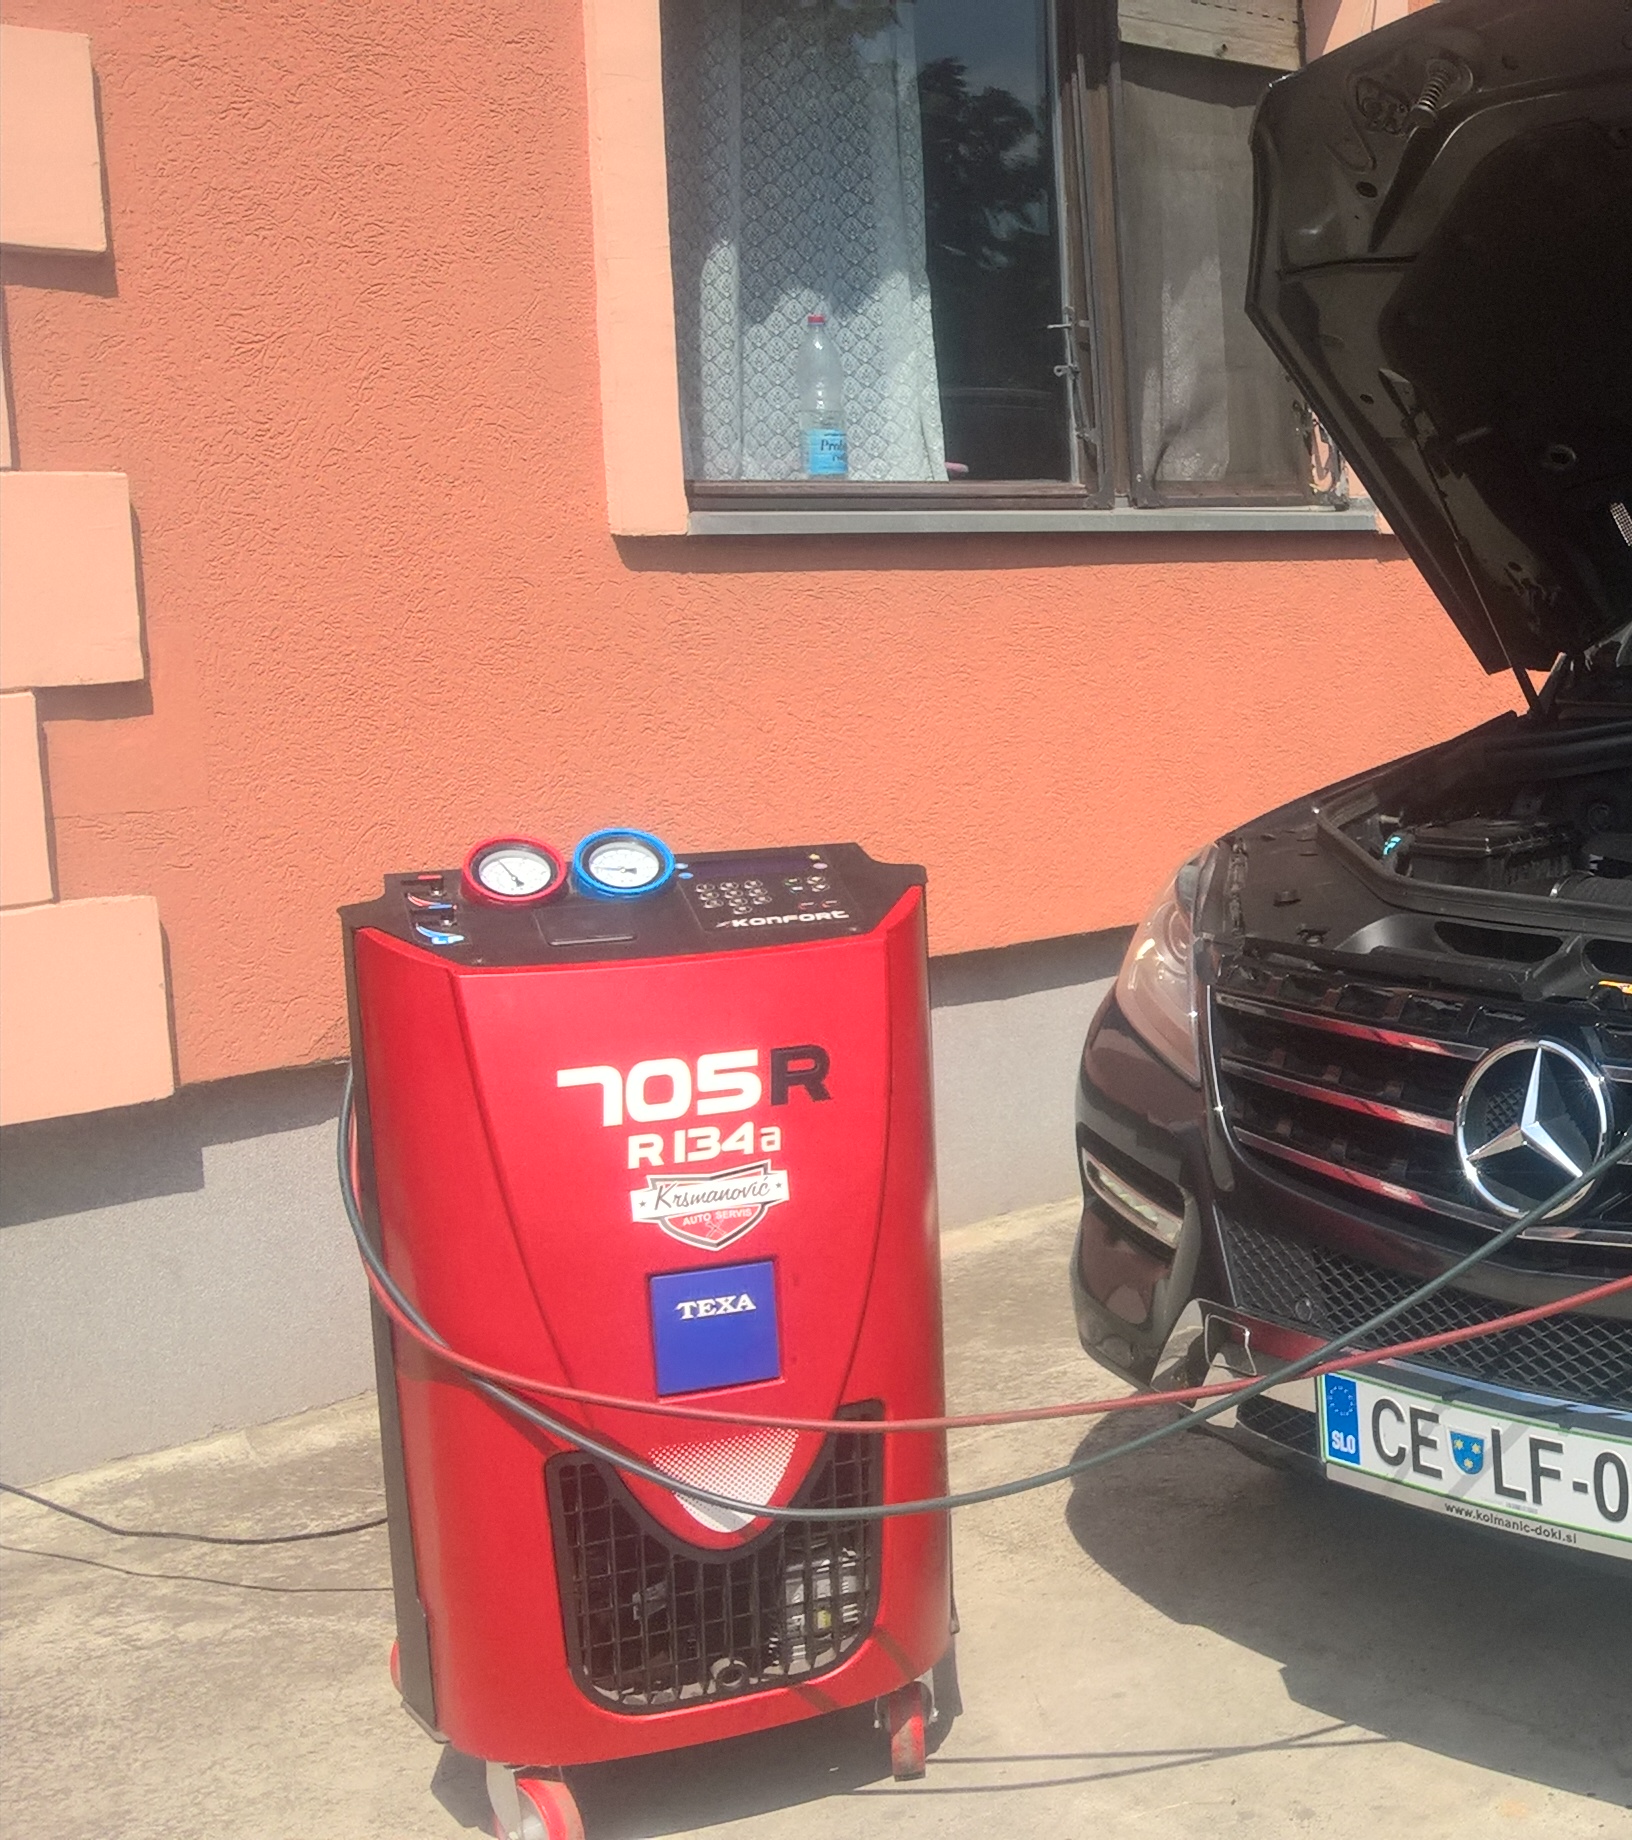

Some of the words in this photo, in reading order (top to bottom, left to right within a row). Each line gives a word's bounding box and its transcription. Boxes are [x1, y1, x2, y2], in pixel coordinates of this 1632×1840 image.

[556, 1044, 832, 1127] 705R
[653, 1176, 771, 1210] Krsmanović
[682, 1213, 711, 1227] AUTO
[715, 1208, 753, 1221] SERVIS
[674, 1293, 757, 1320] TEXA
[1331, 1429, 1356, 1455] SLO
[1371, 1398, 1444, 1480] CE
